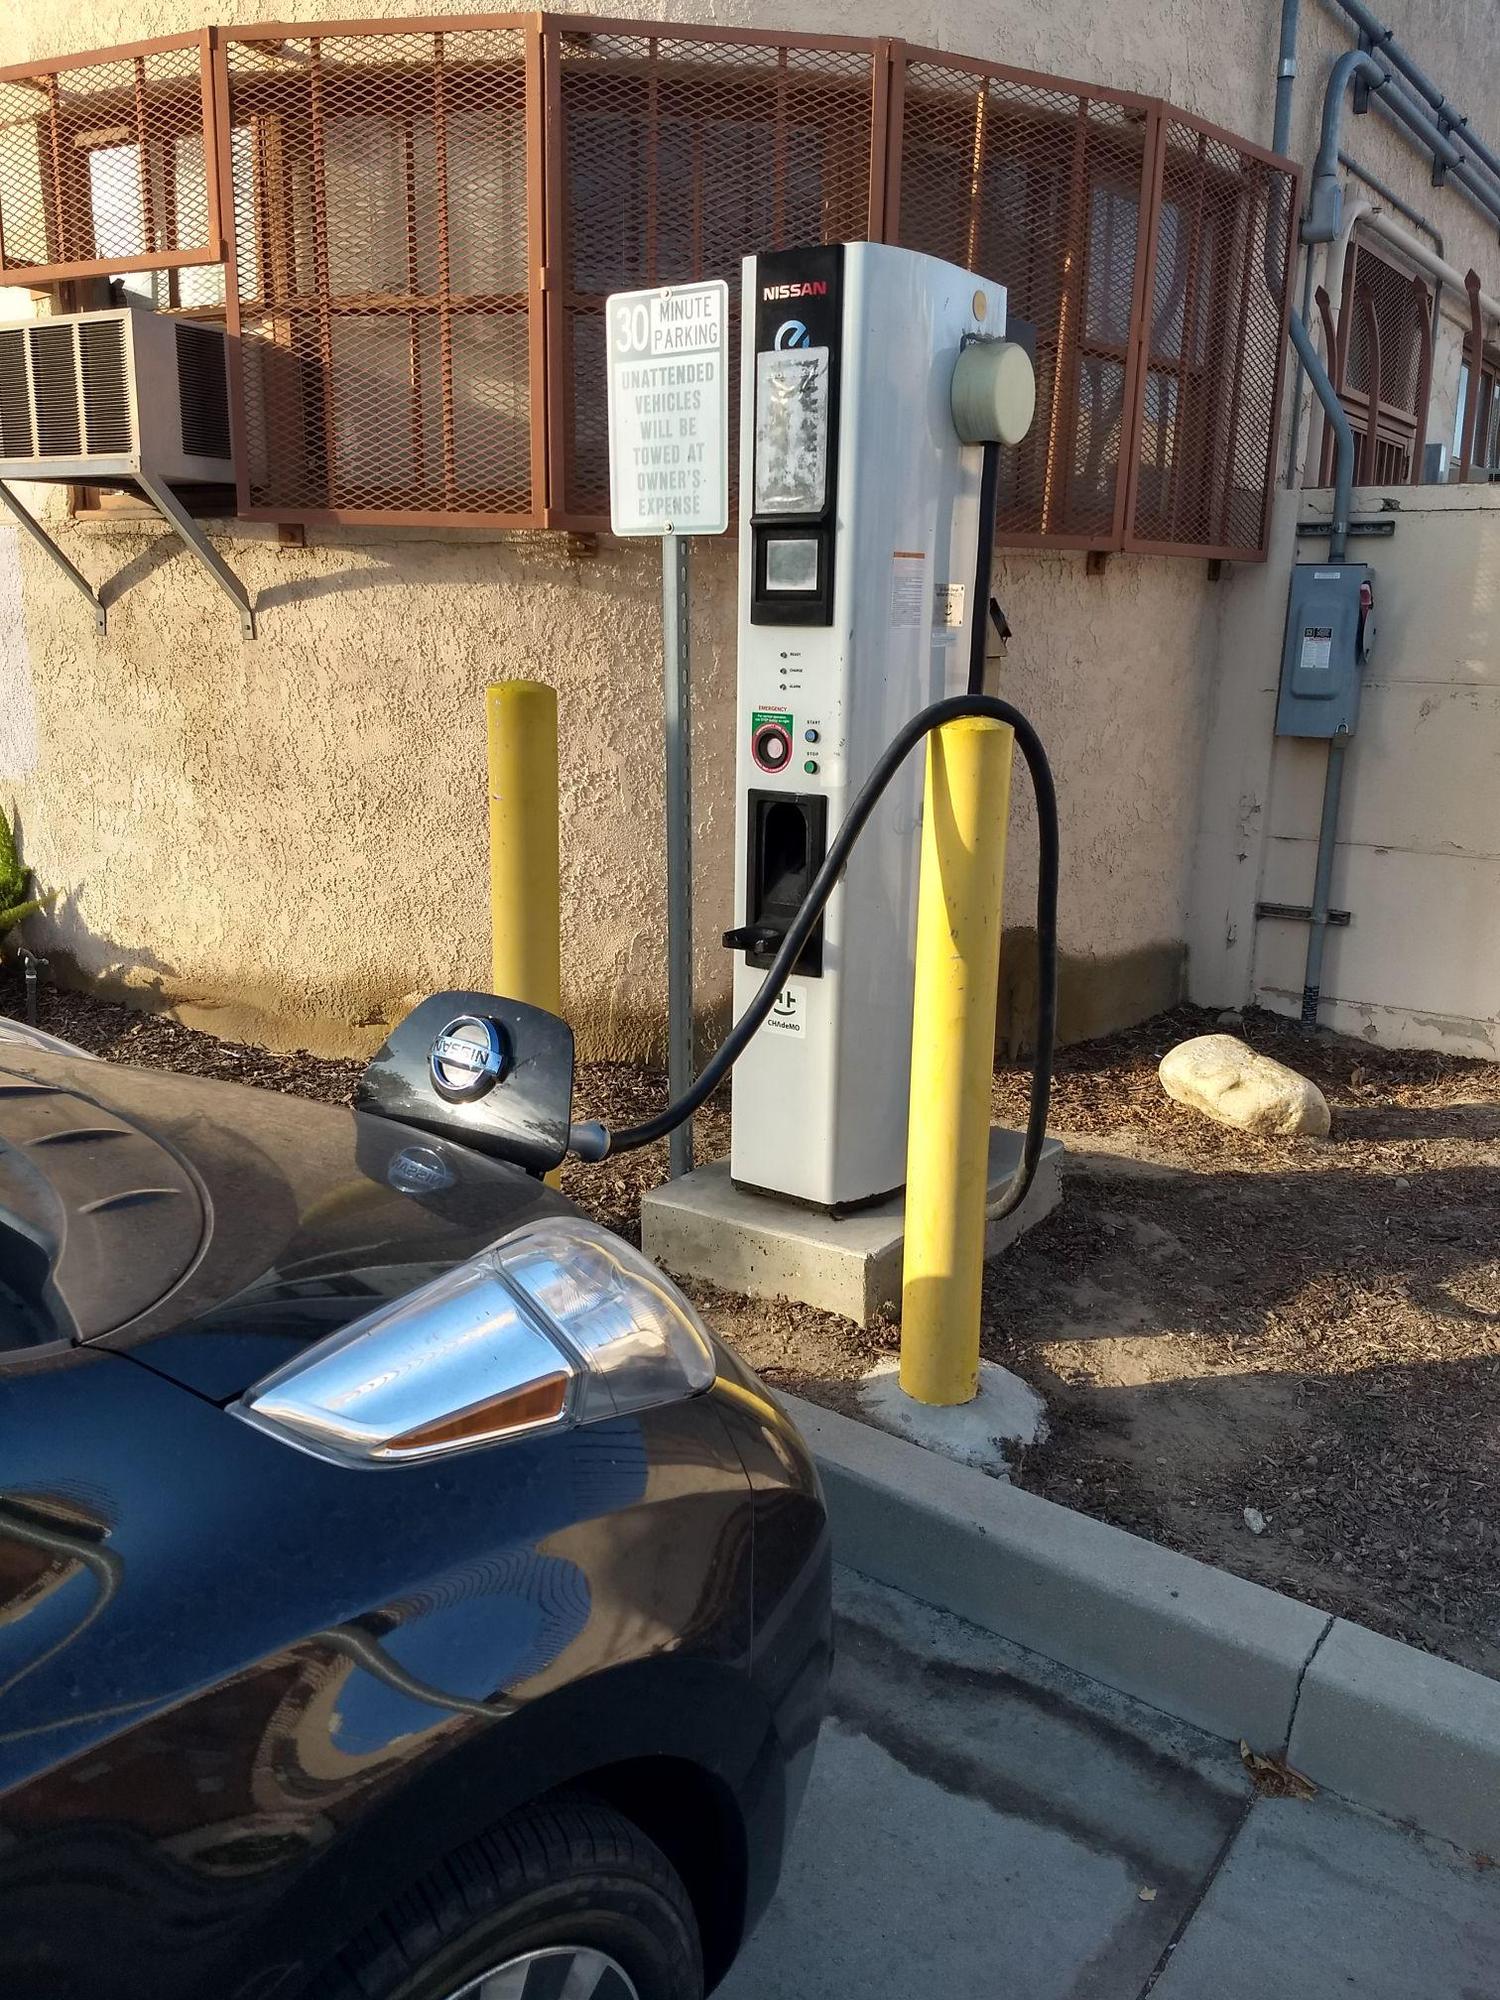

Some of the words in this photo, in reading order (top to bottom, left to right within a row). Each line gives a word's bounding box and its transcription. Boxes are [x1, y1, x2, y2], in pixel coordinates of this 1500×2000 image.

[763, 281, 827, 301] NISSAN
[659, 296, 712, 322] MINUTE
[616, 304, 649, 353] 30
[654, 322, 718, 350] PARKING
[621, 362, 714, 390] UNATTENDED
[635, 390, 701, 415] VEHICLES
[640, 419, 673, 440] WILL
[679, 417, 697, 437] BE
[633, 445, 680, 466] TOWED
[687, 442, 705, 462] AT
[637, 469, 701, 491] OWNER'S
[638, 495, 701, 516] EXPENSE
[434, 1039, 490, 1065] NISSAN
